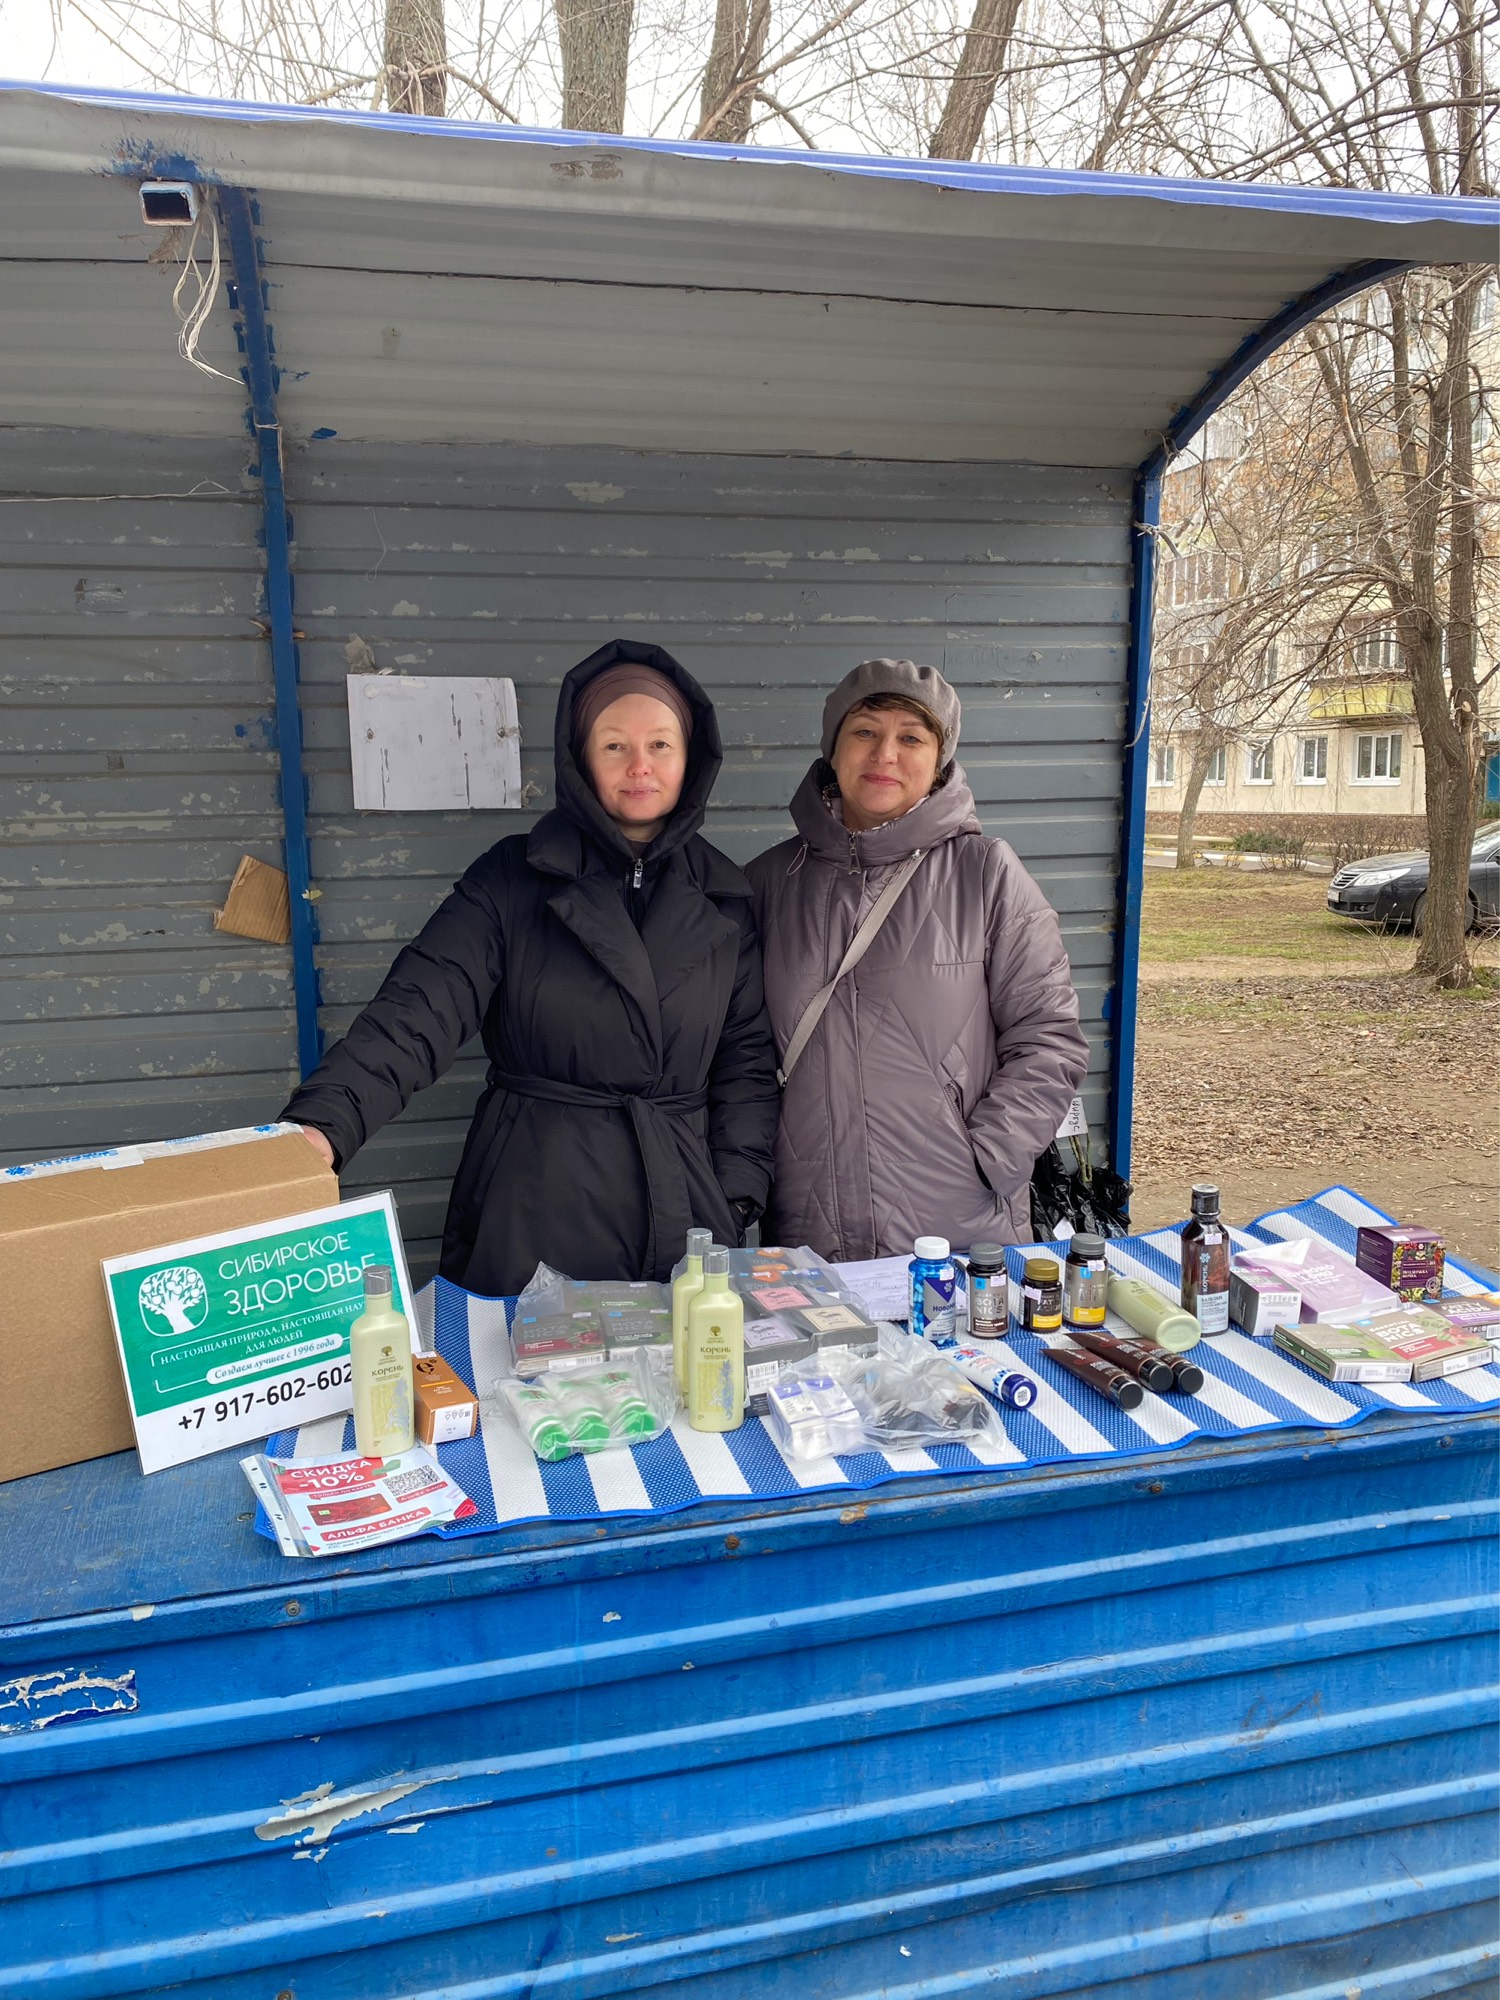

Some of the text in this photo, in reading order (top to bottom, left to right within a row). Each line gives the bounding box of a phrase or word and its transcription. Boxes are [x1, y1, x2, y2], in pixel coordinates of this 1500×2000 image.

[218, 1231, 350, 1280] СИБИРСКОЕ
[160, 1300, 366, 1365] НАСТОЯЩАЯ ПРИРОДА, НАСТОЯЩАЯ НАУ
[245, 1329, 304, 1355] ДЛЯ ЛЮДЕЙ
[1375, 1322, 1422, 1338] BOTA
[1384, 1328, 1425, 1343] NICS
[214, 1363, 253, 1380] Создаем
[253, 1354, 285, 1369] лучшее
[293, 1344, 315, 1358] 1996
[315, 1338, 335, 1352] года
[178, 1362, 352, 1430] +7 917-602-602
[290, 1459, 373, 1479] СКИДКА
[299, 1472, 365, 1489] -10%
[327, 1525, 377, 1540] АЛЬФА
[378, 1510, 425, 1528] БАНКА
